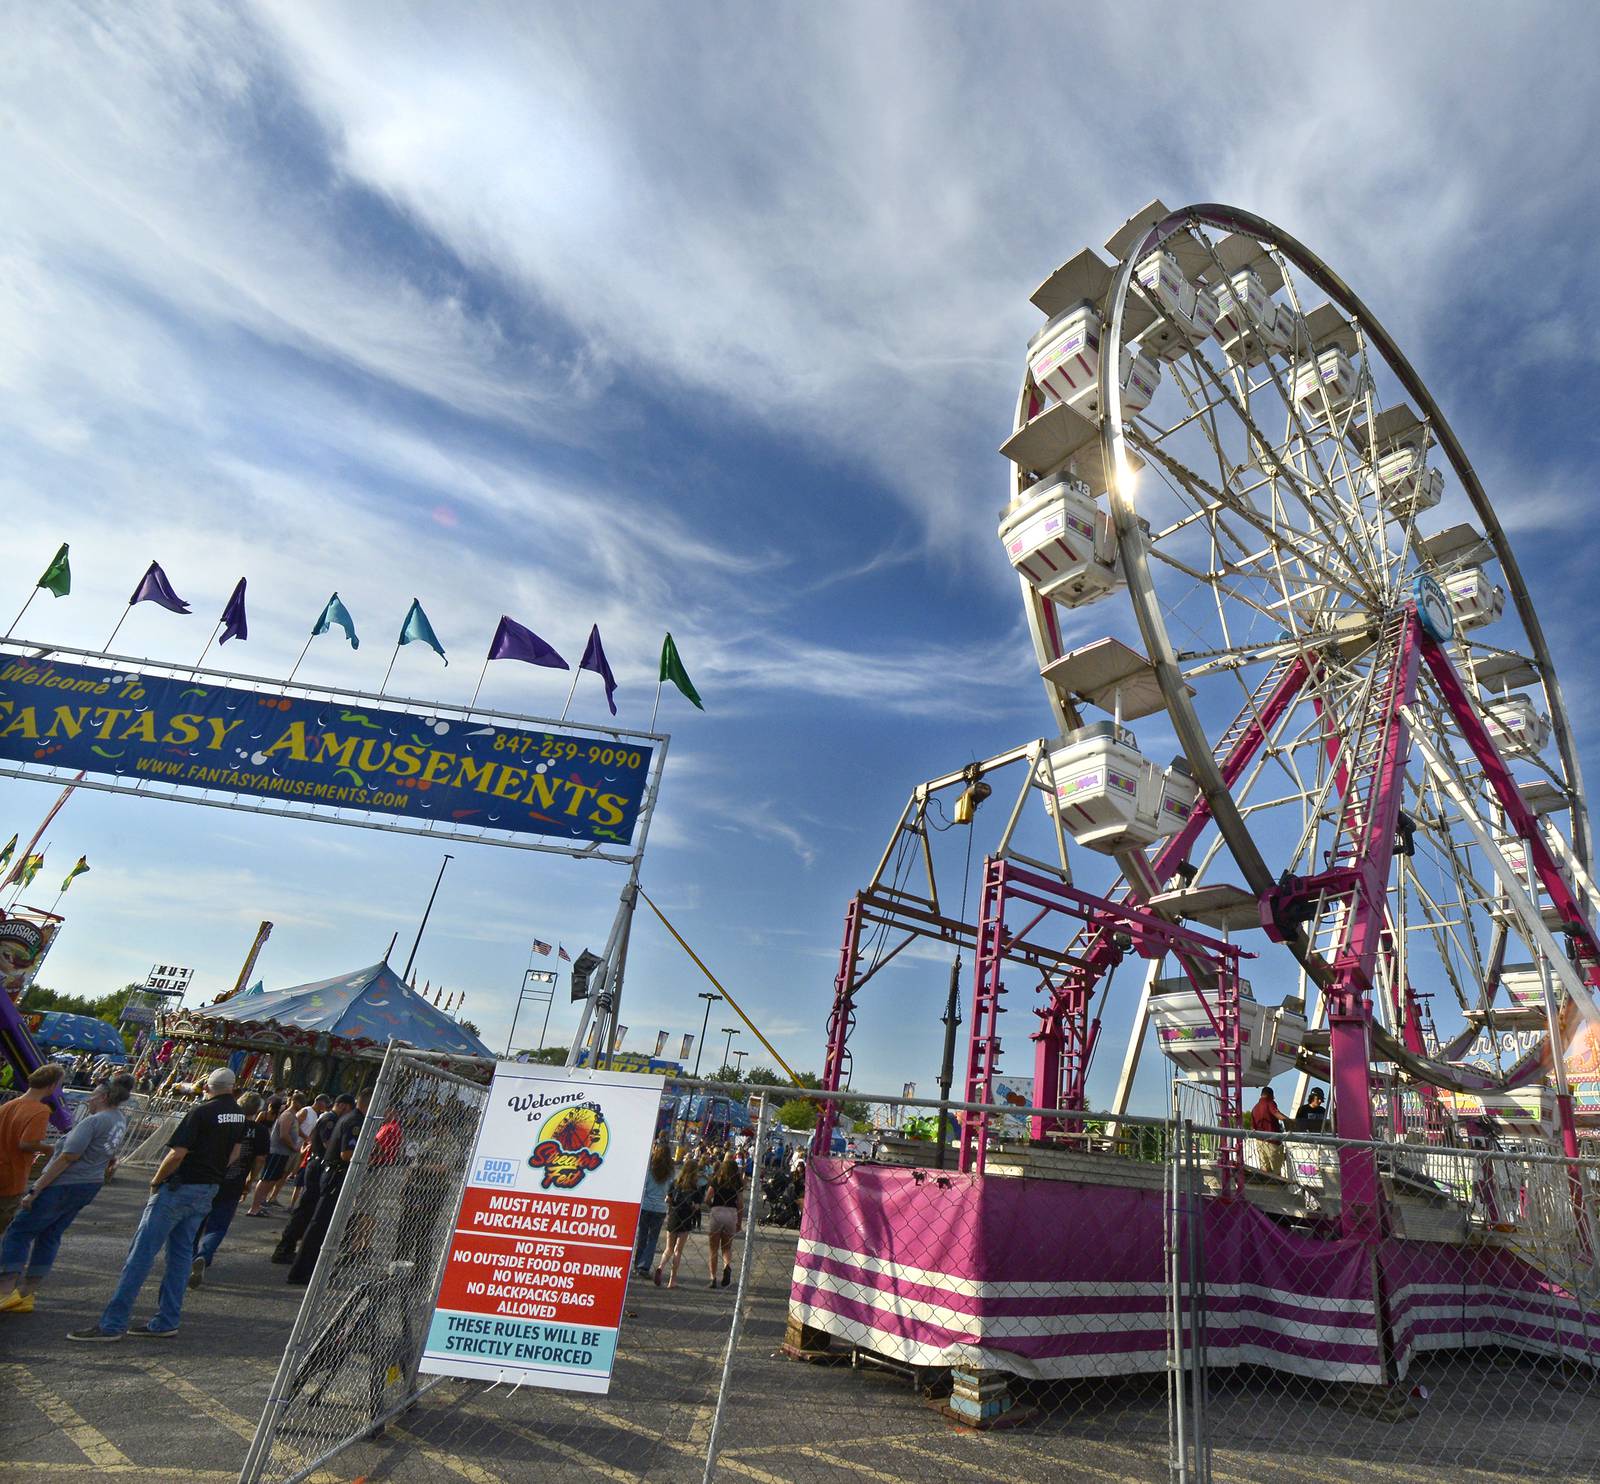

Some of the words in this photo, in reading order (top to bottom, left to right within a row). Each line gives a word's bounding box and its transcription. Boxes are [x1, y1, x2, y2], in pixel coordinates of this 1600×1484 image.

[1075, 479, 1091, 497] 13
[1, 664, 110, 695] Welcome
[118, 680, 146, 701] To
[1119, 729, 1135, 747] 14
[492, 733, 641, 769] 847-259-9090
[136, 757, 409, 808] WWW.FANTASYAMUSEMENTS.COM
[263, 720, 629, 826] AMUSEMENTS
[508, 1091, 585, 1112] Welcome
[527, 1111, 541, 1122] to
[484, 1159, 512, 1172] BUD
[475, 1170, 514, 1184] LIGHT
[542, 1167, 583, 1188] Fest
[489, 1196, 530, 1213] MUST
[531, 1200, 569, 1217] HAVE
[572, 1204, 588, 1218] ID
[591, 1206, 610, 1220] TO
[474, 1212, 549, 1232] PURCHASE
[550, 1219, 617, 1239] ALCOHOL
[515, 1242, 534, 1254] NO
[535, 1244, 565, 1258] PETS
[453, 1250, 471, 1262] NO
[473, 1252, 525, 1268] OUTSIDE
[526, 1258, 561, 1271] FOOD
[562, 1262, 580, 1274] OR
[582, 1265, 623, 1278] DRINK
[493, 1270, 512, 1282] NO
[514, 1272, 574, 1288] WEAPONS
[466, 1282, 485, 1295] NO
[486, 1284, 595, 1307] BACKPACKS/BAGS
[497, 1303, 557, 1318] ALLOWED
[448, 1316, 492, 1335] THESE
[494, 1322, 540, 1341] RULES
[544, 1328, 579, 1345] WILL
[581, 1333, 600, 1347] BE
[445, 1336, 513, 1358] STRICTLY
[514, 1343, 593, 1365] ENFORCED
